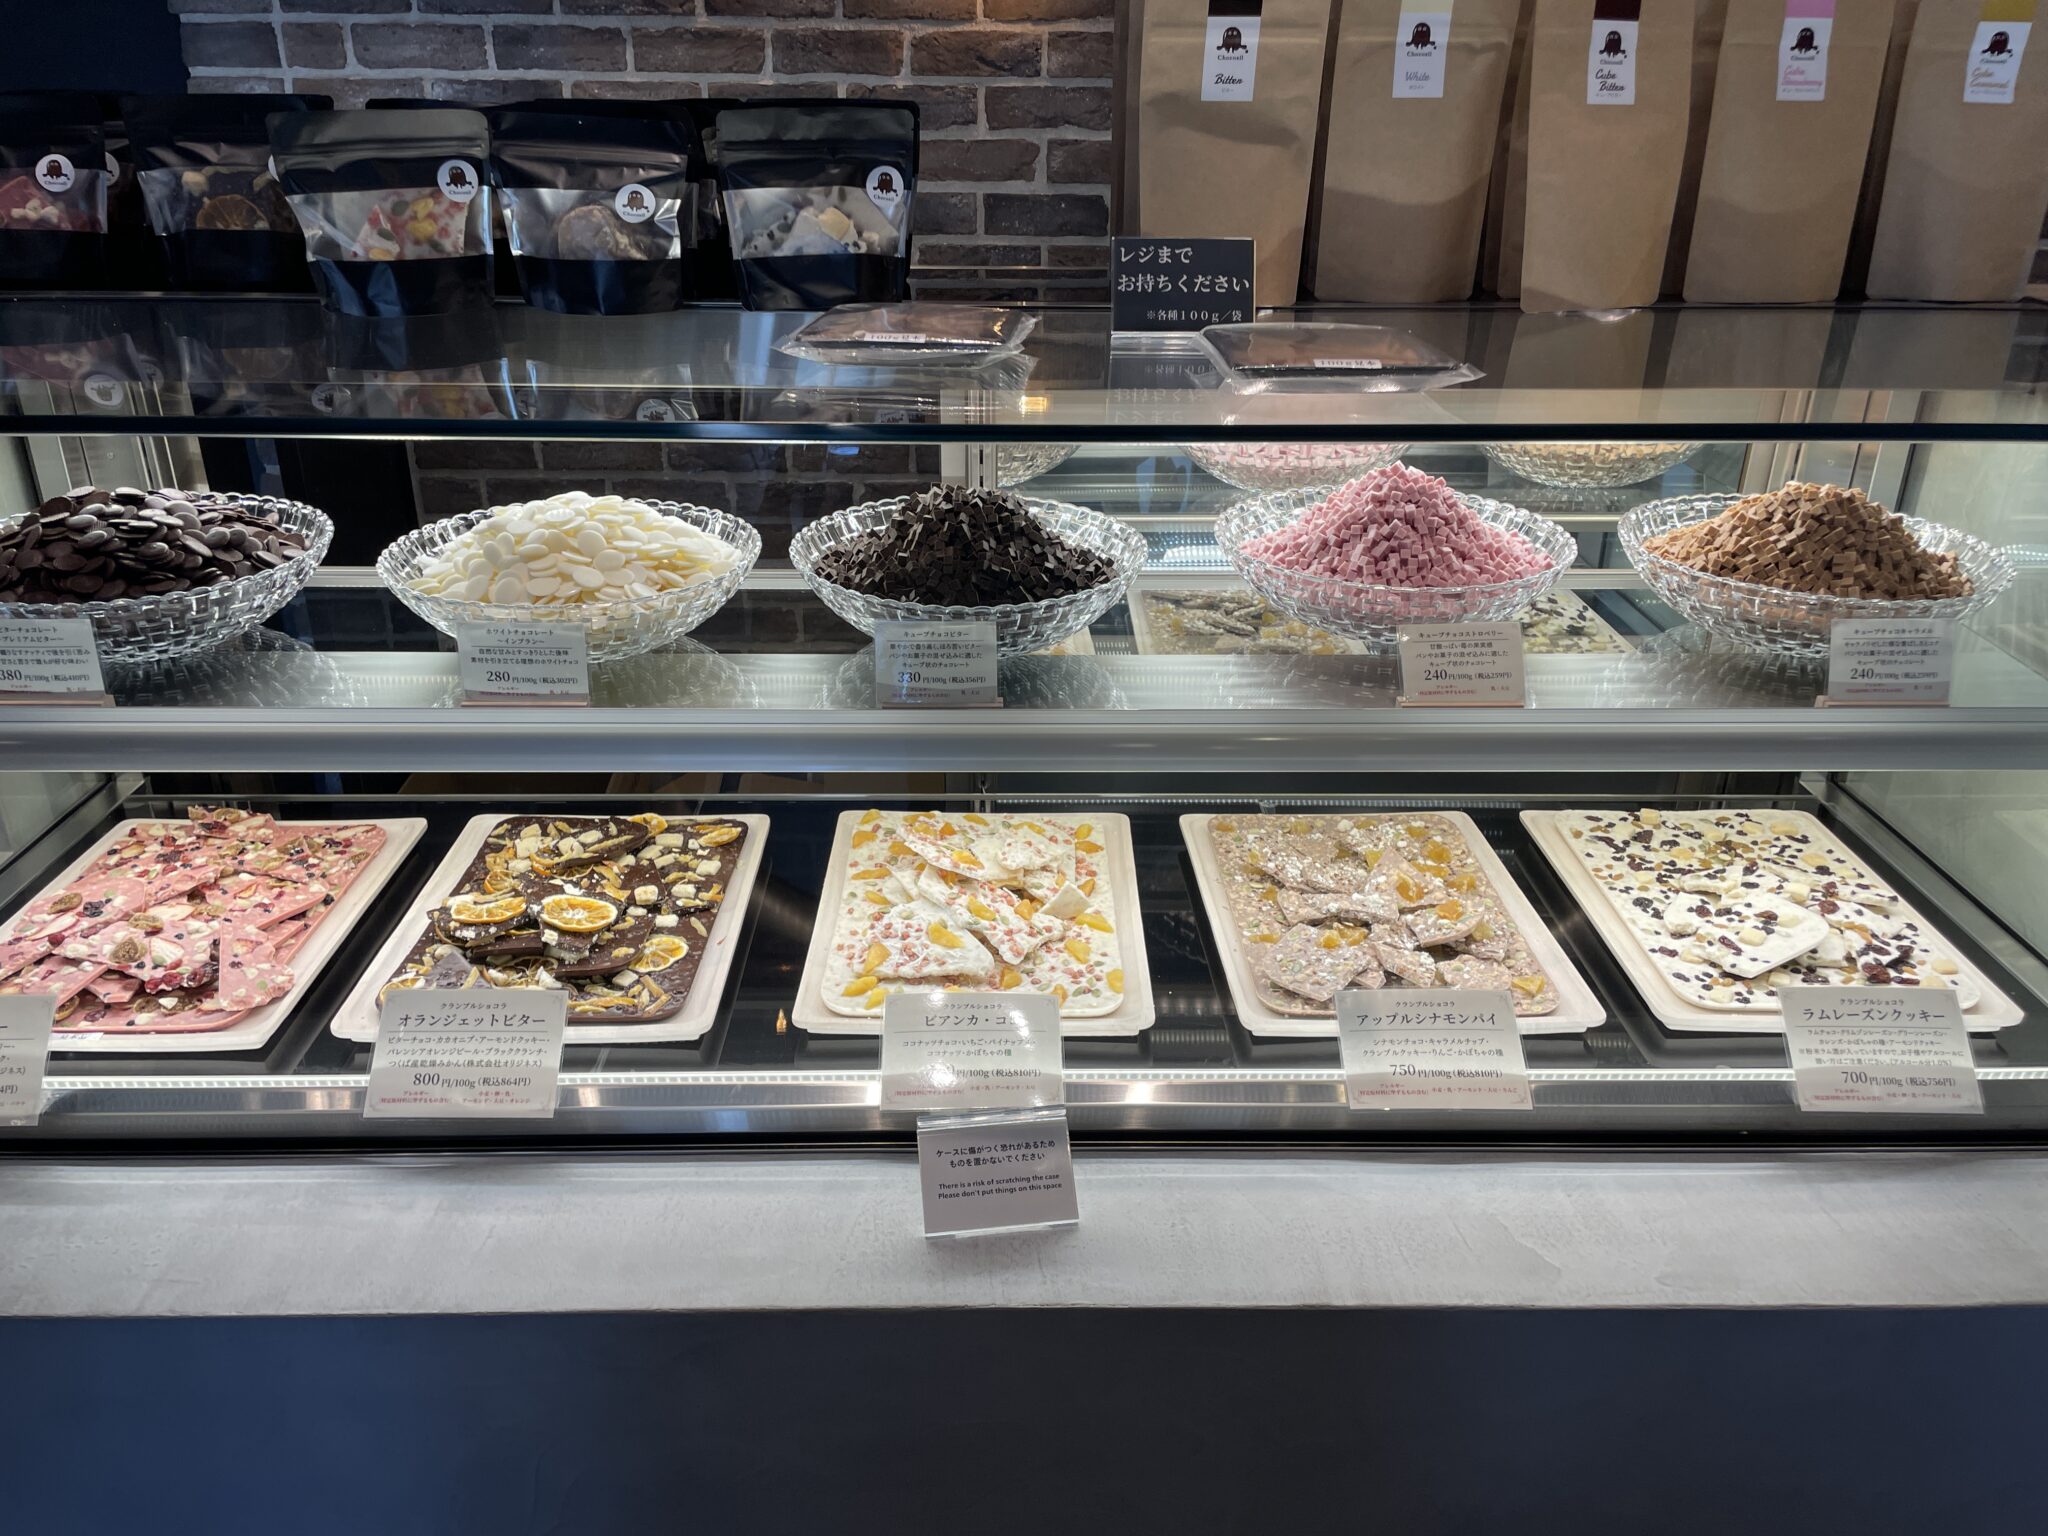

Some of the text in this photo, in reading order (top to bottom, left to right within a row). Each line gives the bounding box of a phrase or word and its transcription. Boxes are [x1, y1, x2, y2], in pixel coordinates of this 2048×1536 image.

[1405, 71, 1431, 82] White
[1119, 245, 1193, 264] レジまで
[1117, 273, 1250, 294] お持ちください
[903, 630, 970, 638] キューブチョコビター
[1419, 630, 1504, 639] キューブチョコストロベリー
[440, 1002, 508, 1010] クランブルショコラ
[1395, 1000, 1456, 1008] クランブルショコラ
[398, 1013, 547, 1028] オランジェットビター
[924, 1013, 1021, 1028] ビアンカ・コ
[1356, 1012, 1498, 1027] アップルシナモンパイ
[1802, 1008, 1946, 1023] ラムレーズンクッキー
[936, 1140, 1056, 1158] ケースに傷がつく恐れがあるため
[949, 1152, 1046, 1169] ものを置かないでください
[938, 1182, 959, 1190] There
[959, 1181, 966, 1189] is
[986, 1179, 995, 1187] of
[995, 1176, 1031, 1185] scratching
[938, 1191, 961, 1200] Please
[961, 1188, 981, 1198] don't
[981, 1188, 994, 1197] put
[995, 1185, 1018, 1195] things
[1028, 1183, 1042, 1191] this
[1043, 1182, 1063, 1191] space
